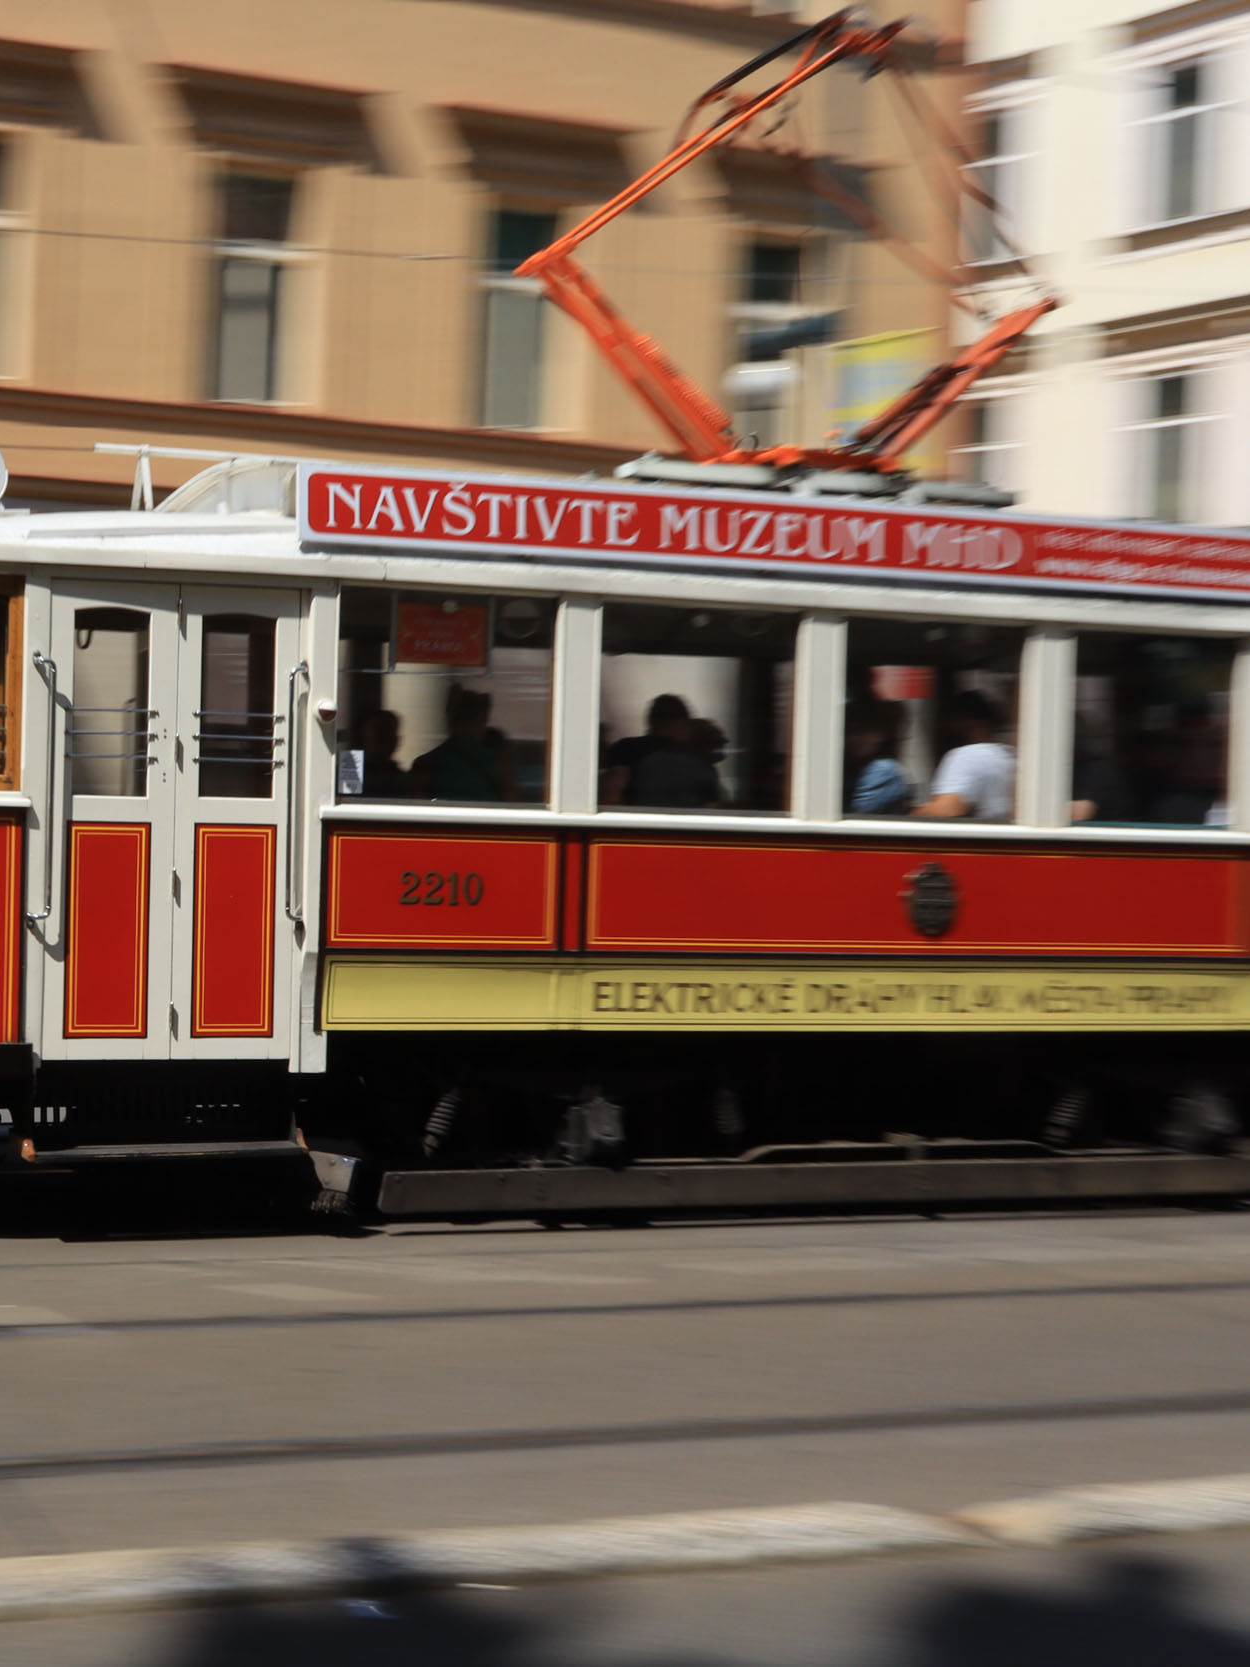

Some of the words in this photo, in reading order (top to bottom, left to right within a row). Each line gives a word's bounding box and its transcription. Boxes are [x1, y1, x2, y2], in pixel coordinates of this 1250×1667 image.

[326, 481, 641, 546] NAVŠTIVTE
[658, 504, 887, 563] MUZEUM
[399, 870, 485, 906] 2210
[593, 977, 796, 1014] ELEKTRICKÉ
